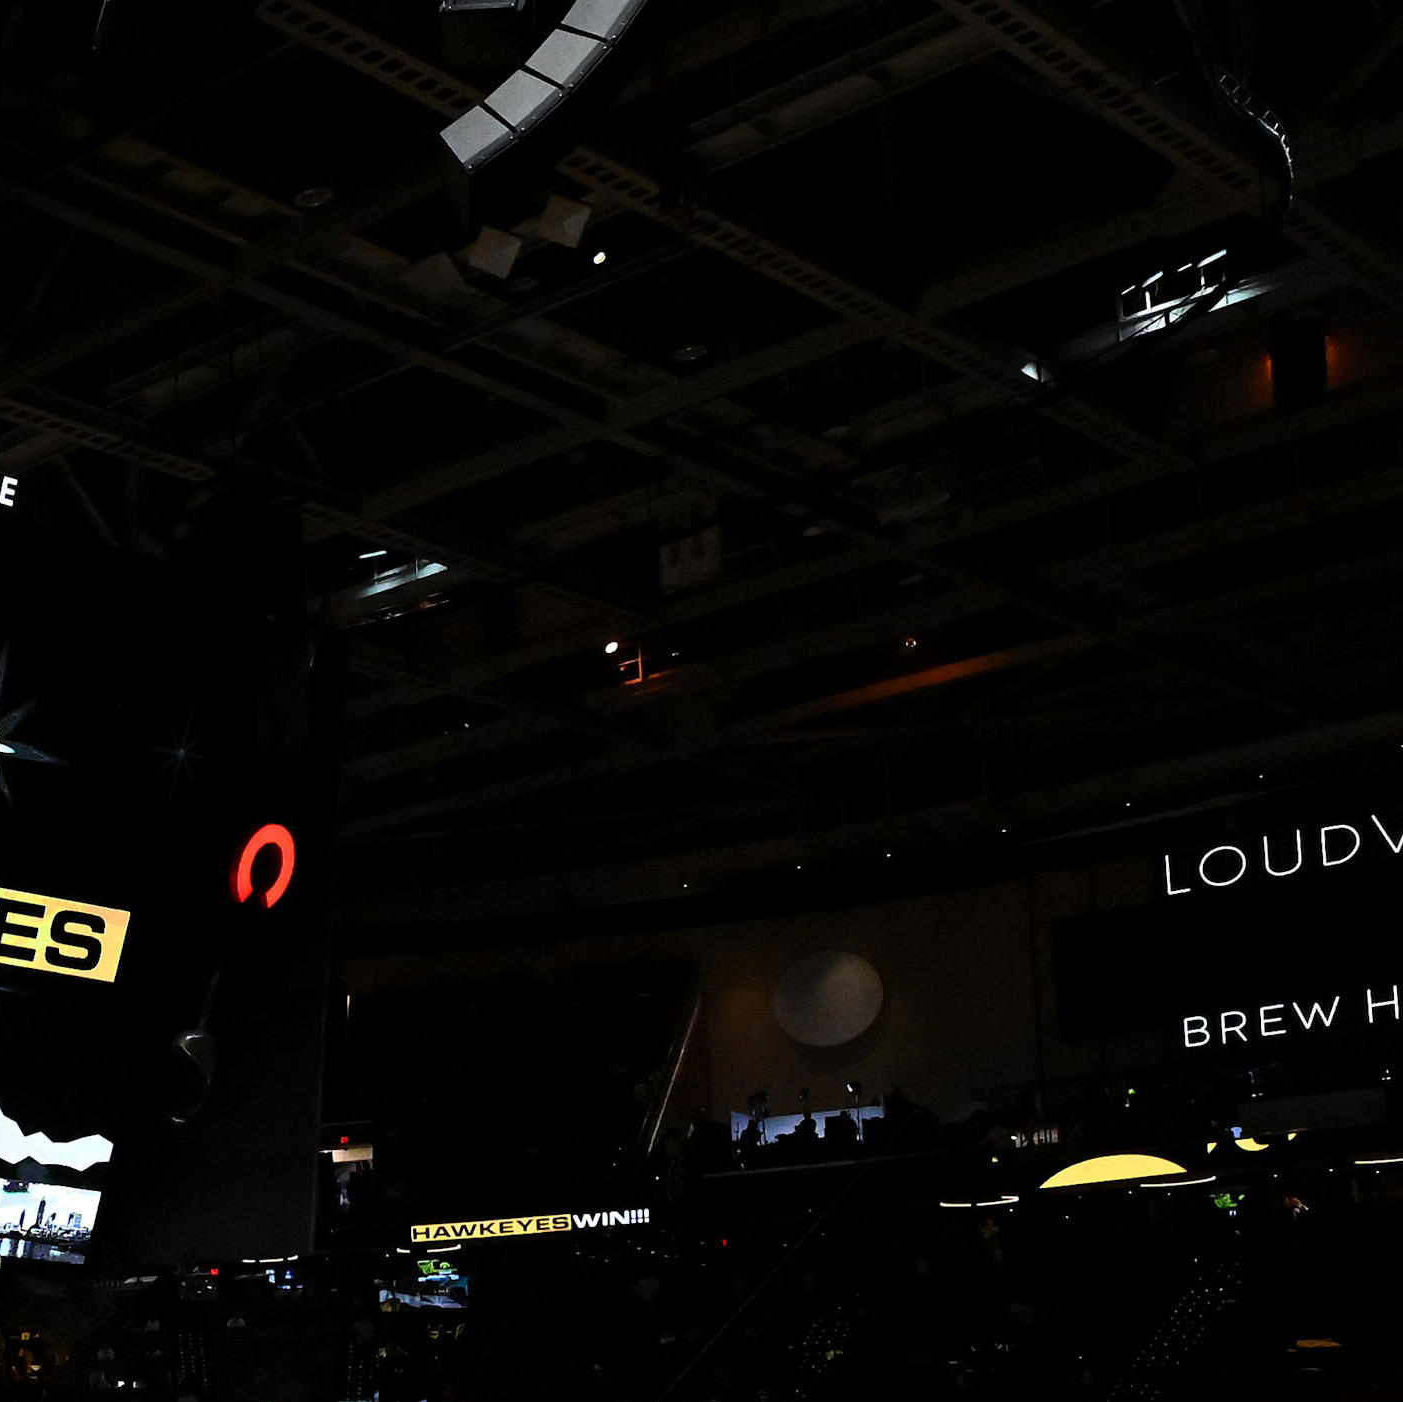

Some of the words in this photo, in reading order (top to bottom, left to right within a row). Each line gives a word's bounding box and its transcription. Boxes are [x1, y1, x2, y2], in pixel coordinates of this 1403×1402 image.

[1184, 996, 1341, 1048] BREW
[412, 1216, 570, 1240] HAWKEYES
[572, 1208, 650, 1229] WIN!!!
